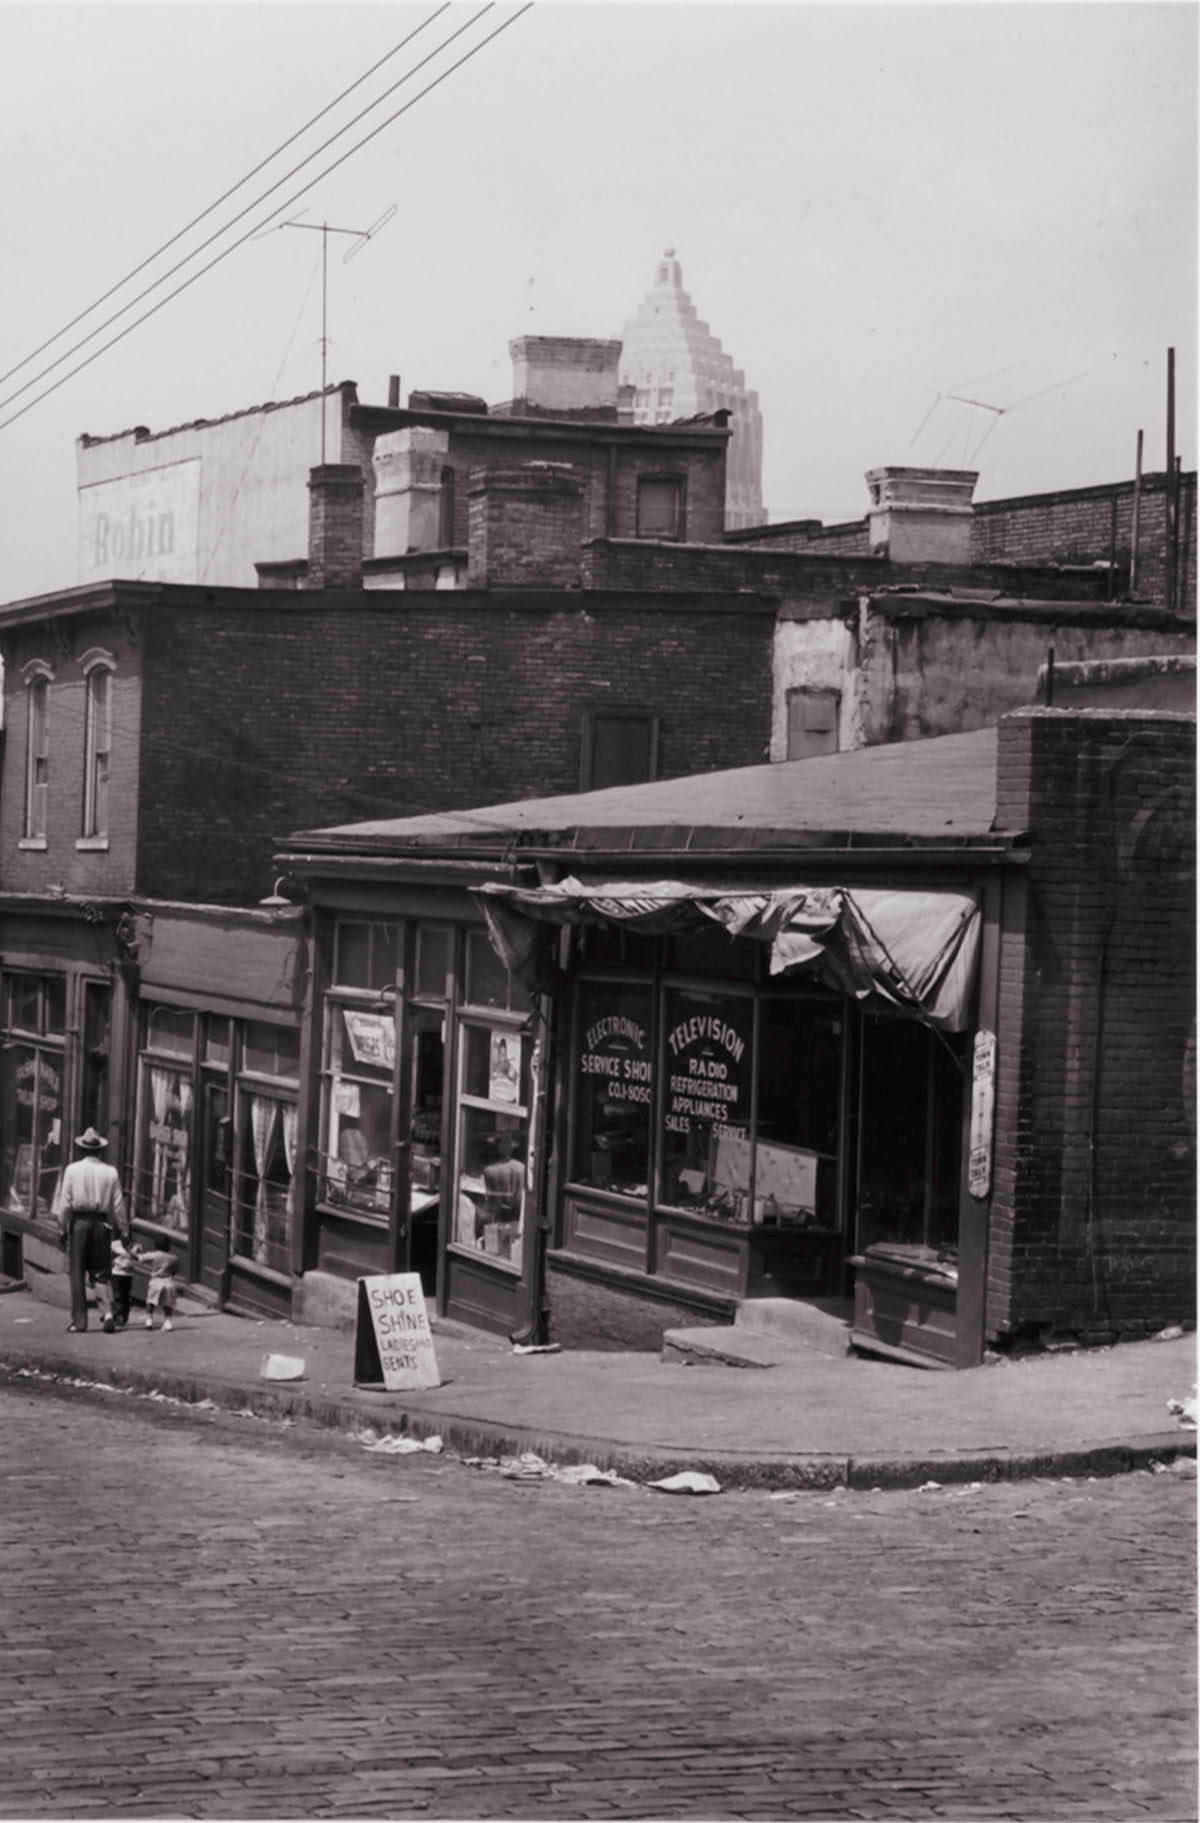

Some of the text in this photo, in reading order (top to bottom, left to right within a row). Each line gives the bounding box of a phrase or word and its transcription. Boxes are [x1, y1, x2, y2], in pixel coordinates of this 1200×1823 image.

[89, 502, 175, 567] Robin
[586, 1016, 645, 1051] ELECTRONIC
[668, 1016, 745, 1063] TELEVISION
[581, 1054, 620, 1077] SERVICE
[688, 1058, 728, 1080] RADIO
[670, 1075, 738, 1102] REFRIGERATION
[672, 1096, 728, 1121] APPLIANCES
[664, 1114, 746, 1139] SALES SERVICE
[371, 1289, 416, 1309] SHOE
[378, 1310, 426, 1335] SHINE
[383, 1354, 419, 1372] GENTS
